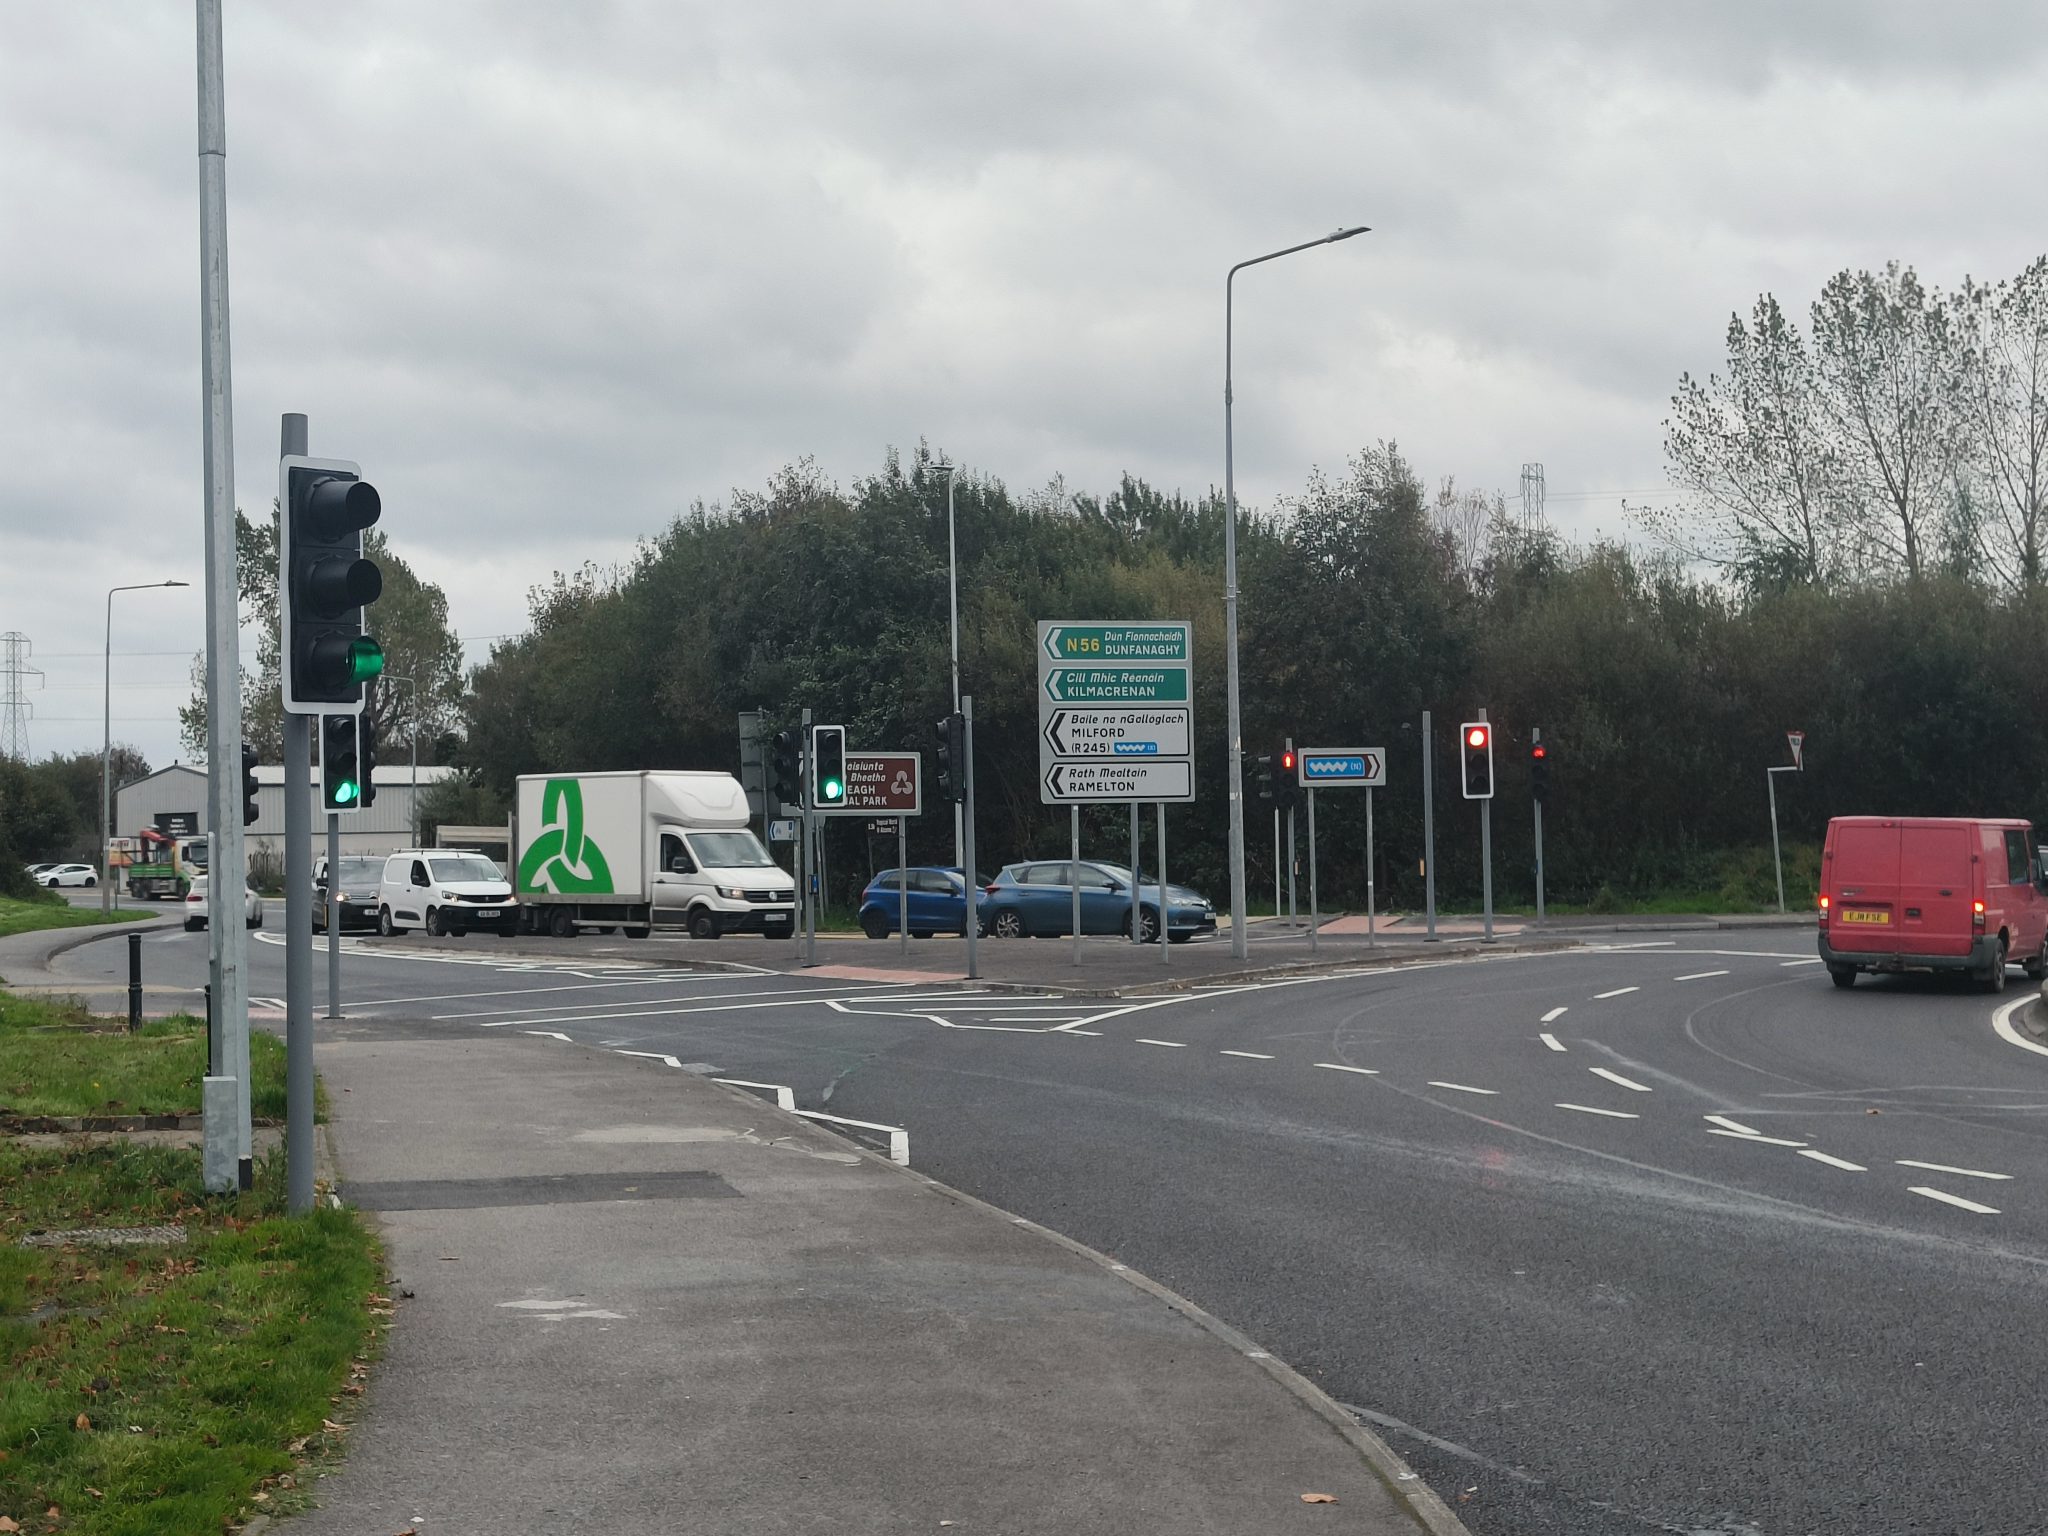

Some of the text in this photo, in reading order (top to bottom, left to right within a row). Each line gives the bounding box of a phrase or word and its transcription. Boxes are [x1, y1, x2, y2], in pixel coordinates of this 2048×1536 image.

[1066, 638, 1100, 652] N56
[1105, 644, 1180, 655] DUNFANAGHY
[1066, 672, 1086, 683] Cill
[1090, 672, 1117, 683] Mhic
[1067, 686, 1155, 697] KILMACRENAN
[1071, 714, 1098, 724] Baile
[1102, 716, 1116, 724] na
[1071, 728, 1125, 738] MILFORD
[1071, 742, 1110, 753] (R245)
[850, 772, 886, 782] Bheatha
[1099, 768, 1147, 778] Mealtain
[1069, 781, 1135, 792] RAMELTON
[862, 796, 888, 806] PARK
